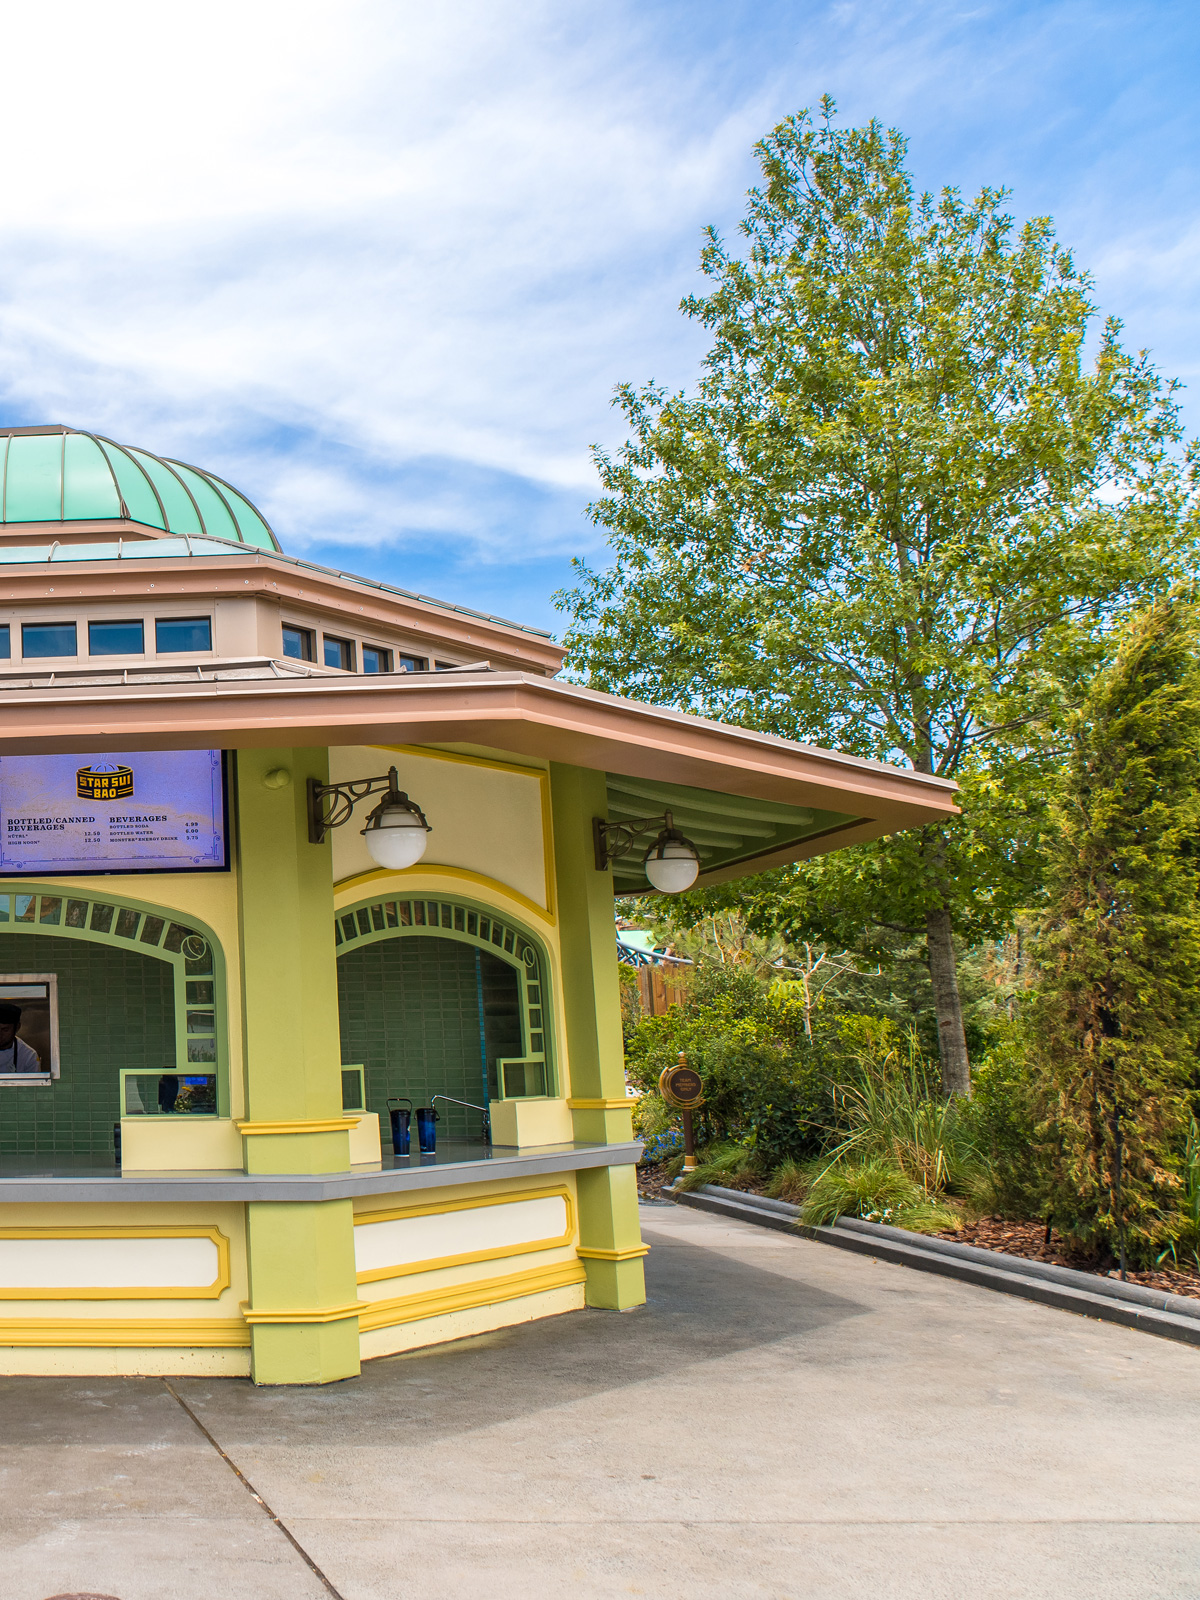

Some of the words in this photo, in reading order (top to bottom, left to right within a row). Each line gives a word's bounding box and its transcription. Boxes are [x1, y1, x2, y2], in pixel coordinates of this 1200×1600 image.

[80, 776, 109, 788] STAR
[111, 775, 131, 787] SUI
[93, 788, 117, 798] BAO
[7, 817, 95, 825] BOTTLED/CANNED
[109, 815, 167, 823] BEVERAGES
[7, 824, 65, 832] BEVERAGES
